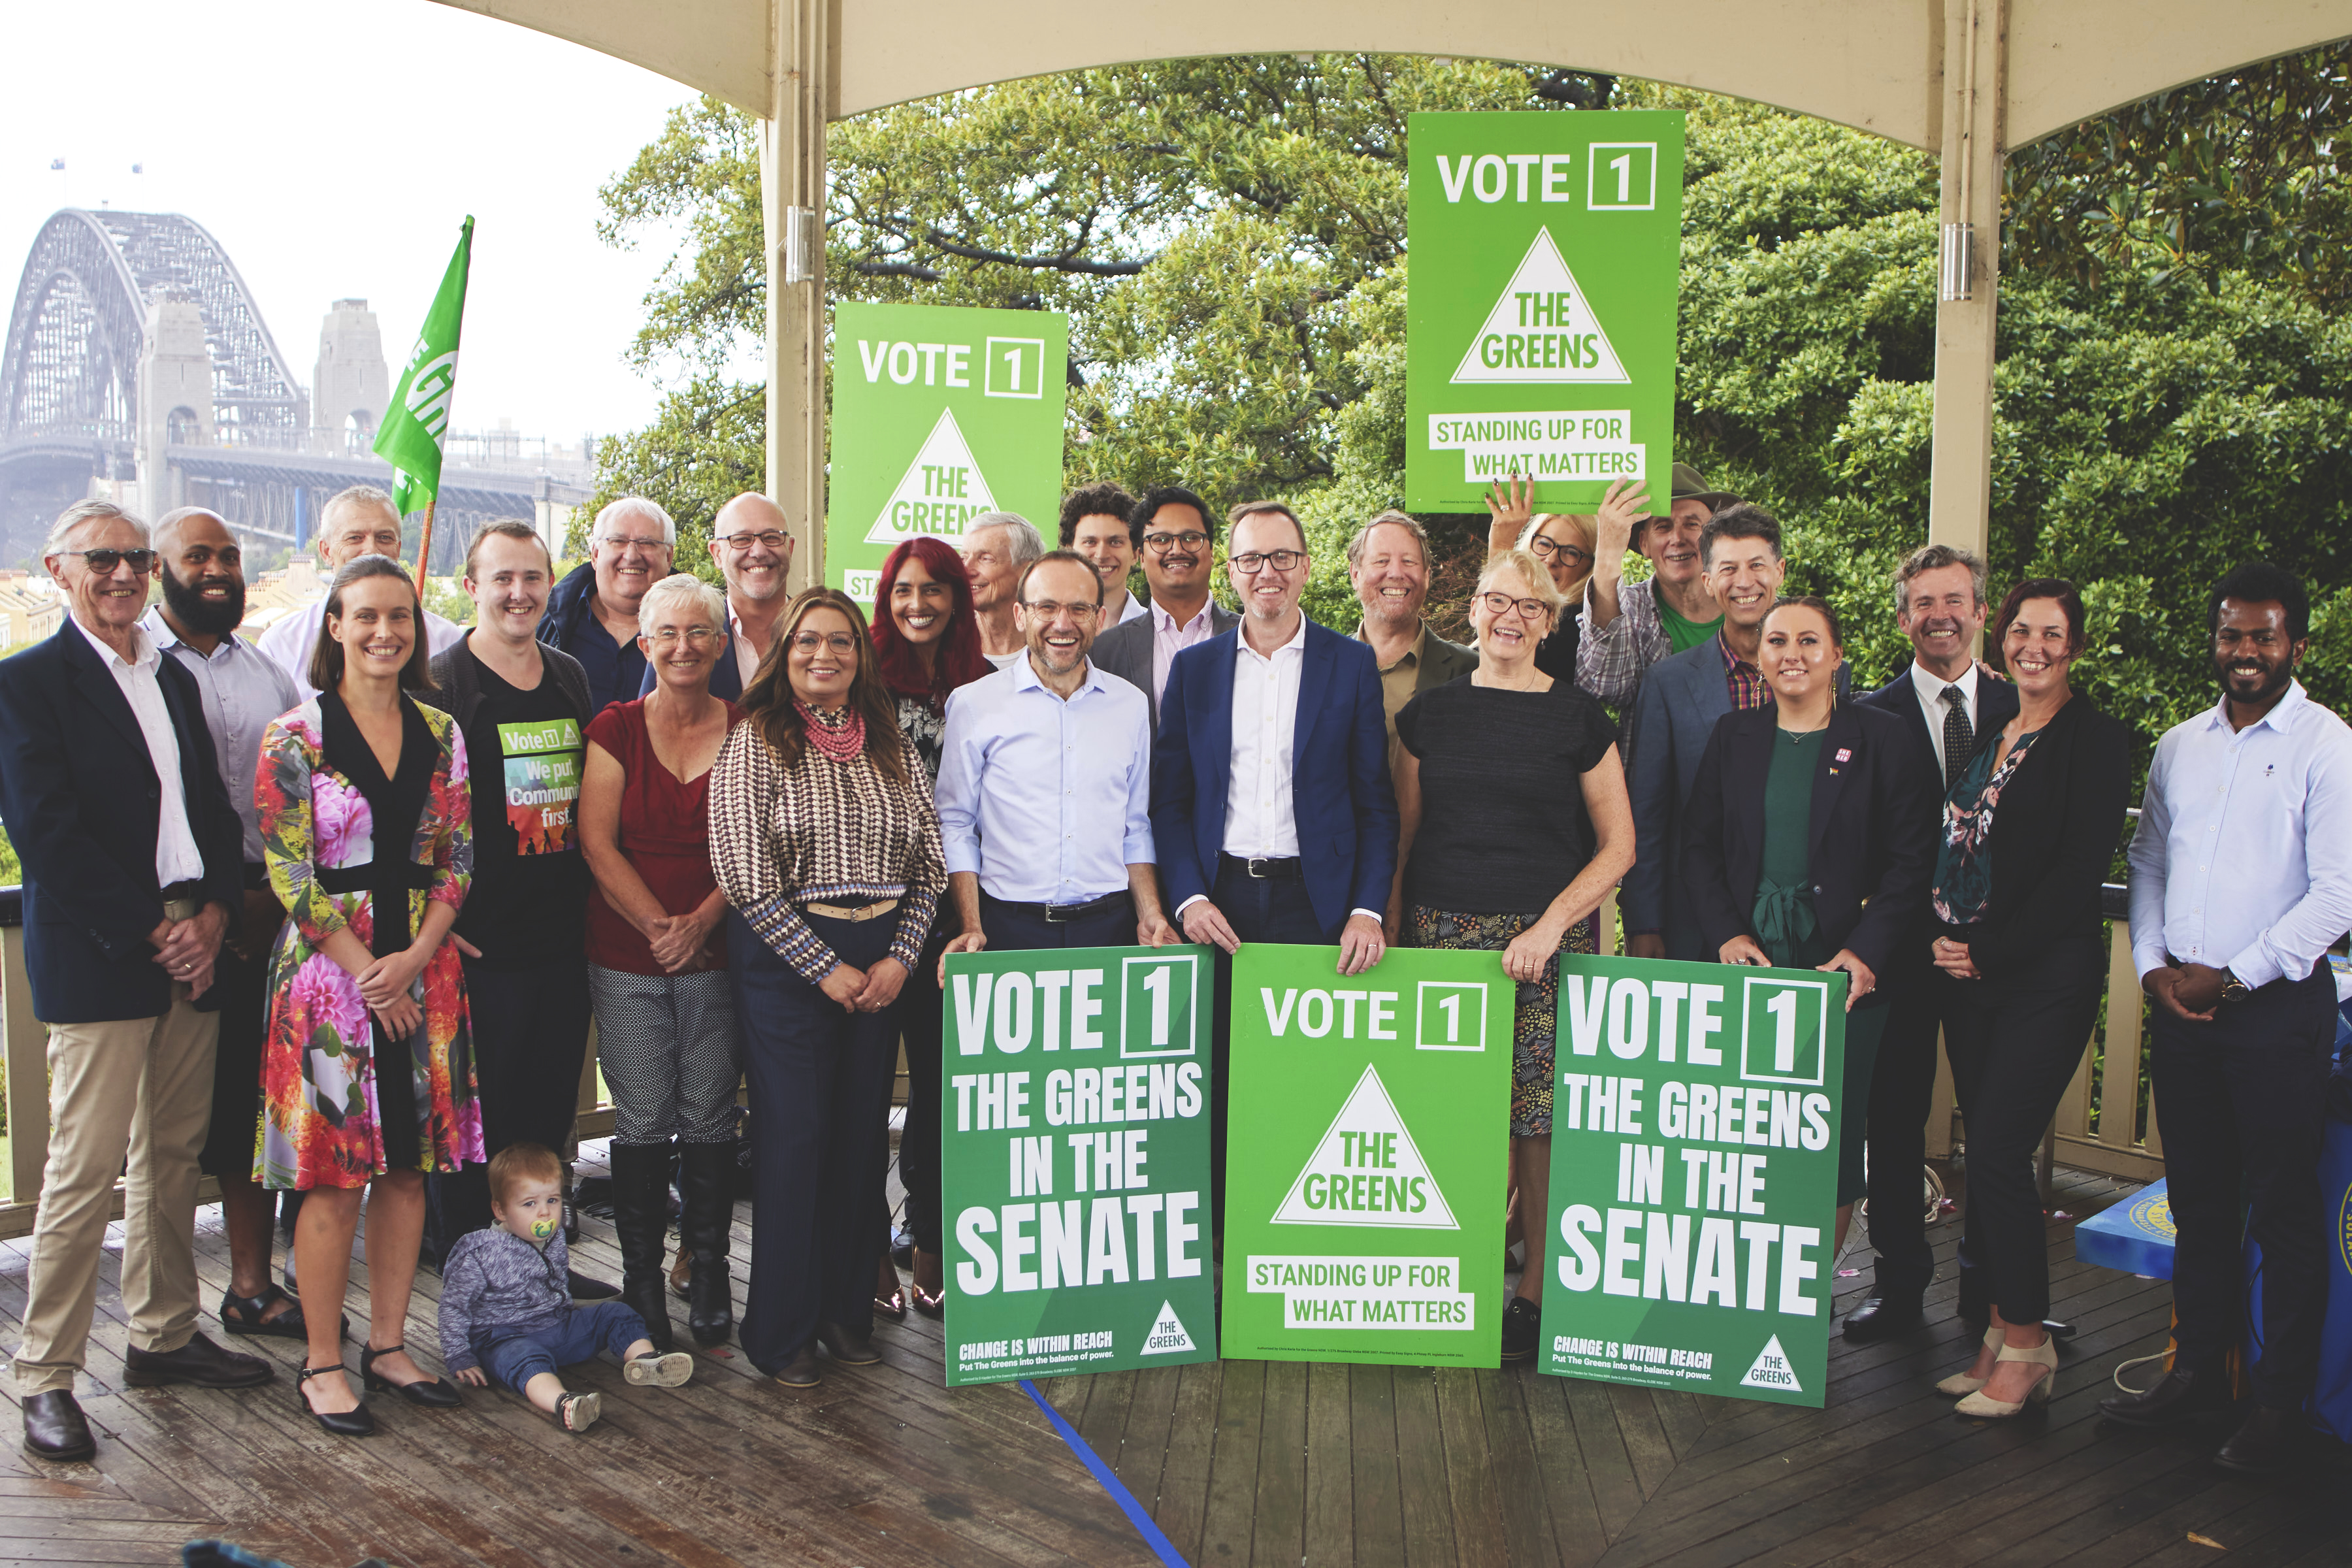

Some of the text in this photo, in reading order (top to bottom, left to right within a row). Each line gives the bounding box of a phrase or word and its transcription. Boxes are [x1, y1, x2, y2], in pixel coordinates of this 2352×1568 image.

[1437, 154, 1630, 203] VOTE 1
[1514, 292, 1570, 327] THE
[858, 340, 1021, 390] VOTE 1
[1481, 333, 1599, 368] GREENS
[1437, 418, 1622, 443] STANDING UP FOR
[1473, 452, 1638, 476] WHAT MATTERS
[922, 465, 969, 498] THE
[505, 732, 554, 750] Vote 1
[525, 759, 574, 782] We put
[541, 808, 572, 827] first.
[953, 966, 1169, 1055] VOTE 1
[1260, 987, 1460, 1041] VOTE 1
[1567, 974, 1796, 1072] VOTE 1
[952, 1062, 1202, 1132] THE GREENS
[1564, 1073, 1831, 1151] THE GREENS
[1010, 1129, 1148, 1197] IN THE
[1339, 1131, 1397, 1169] THE
[1303, 1173, 1427, 1213] GREENS
[1618, 1143, 1767, 1215] IN THE
[956, 1191, 1201, 1296] SENATE
[1558, 1204, 1820, 1316] SENATE
[1255, 1264, 1450, 1287] STANDING UP FOR
[1158, 1321, 1176, 1335] THE
[1293, 1299, 1466, 1323] WHAT MATTERS
[959, 1331, 1112, 1360] CHANGE IS WITHIN REACH
[1149, 1333, 1186, 1349] GREENS
[1554, 1335, 1712, 1369] CHANGE IS WITHIN REACH
[959, 1363, 973, 1371] Put
[974, 1361, 989, 1370] The
[1036, 1355, 1047, 1365] the
[1049, 1354, 1078, 1363] balance
[1090, 1352, 1113, 1361] power.
[1552, 1354, 1566, 1363] Put
[1568, 1356, 1582, 1365] The
[1584, 1358, 1611, 1368] Greens
[1613, 1361, 1627, 1370] into
[1629, 1363, 1642, 1372] the
[1644, 1366, 1674, 1376] balance
[1686, 1371, 1711, 1380] power.
[1751, 1368, 1791, 1386] GREENS
[1764, 1356, 1782, 1370] THE
